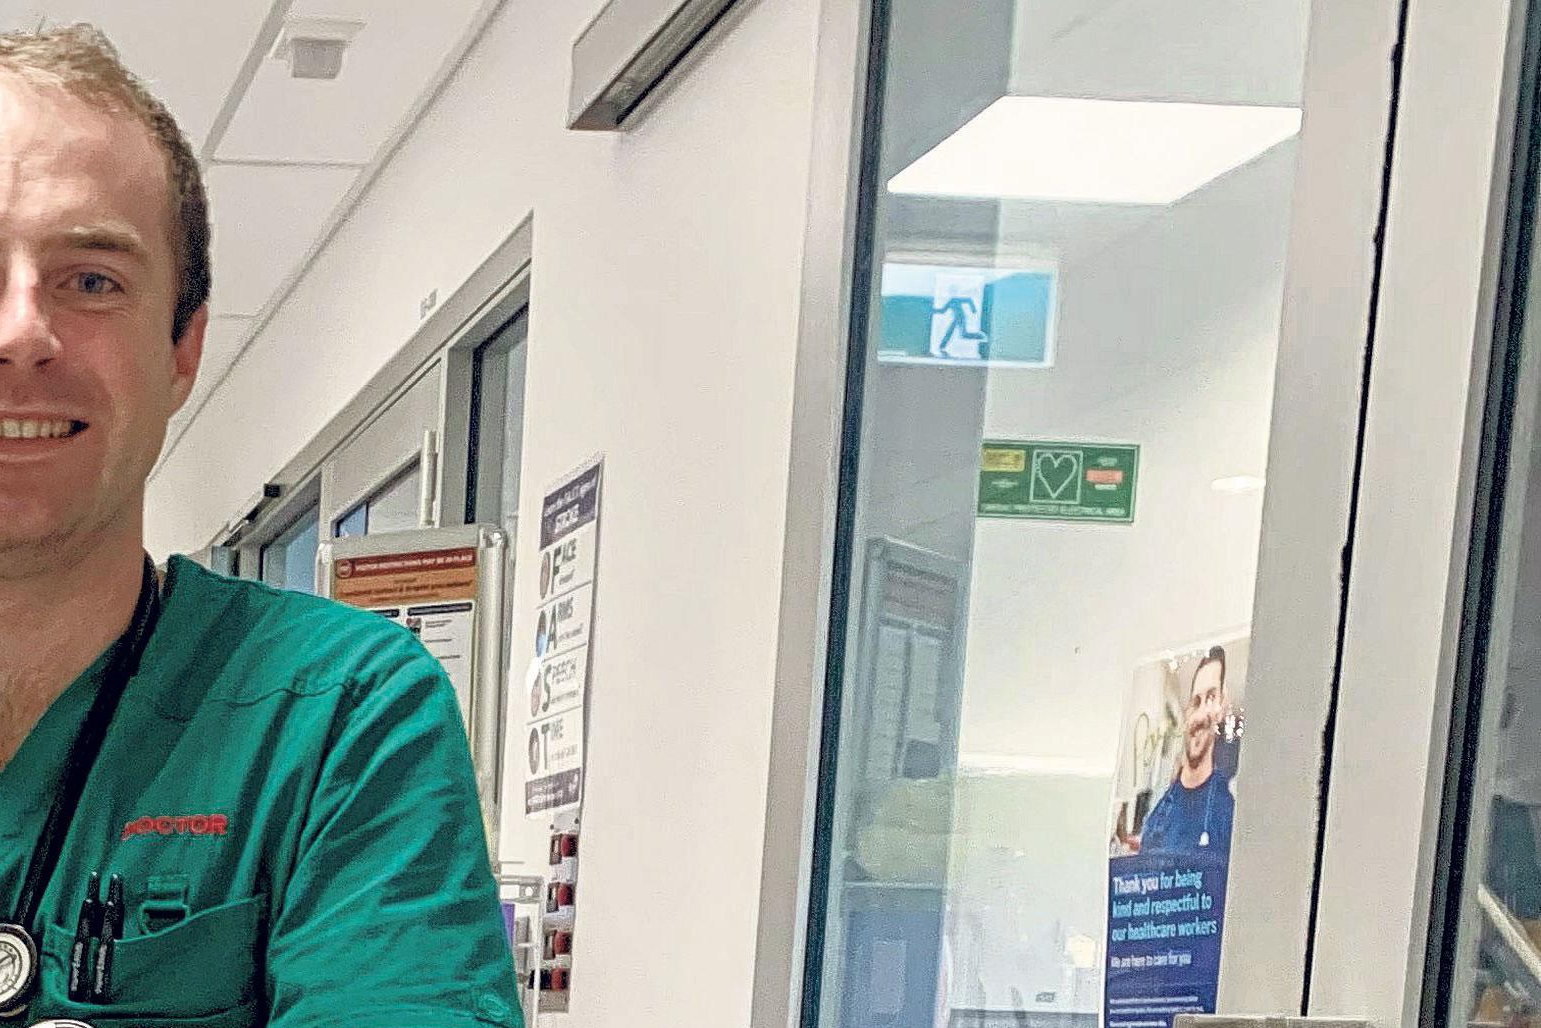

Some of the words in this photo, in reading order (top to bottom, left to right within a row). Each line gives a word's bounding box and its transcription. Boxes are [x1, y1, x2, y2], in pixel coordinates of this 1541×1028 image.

[1112, 873, 1140, 895] Thank
[1141, 877, 1158, 894] you
[1159, 872, 1174, 889] for
[1175, 869, 1202, 889] being
[1112, 899, 1132, 918] kind
[1133, 897, 1150, 916] and
[1151, 893, 1199, 915] respectful
[1201, 893, 1212, 910] to
[1111, 928, 1127, 941] our
[1127, 920, 1176, 940] healthcare
[1177, 916, 1217, 936] workers
